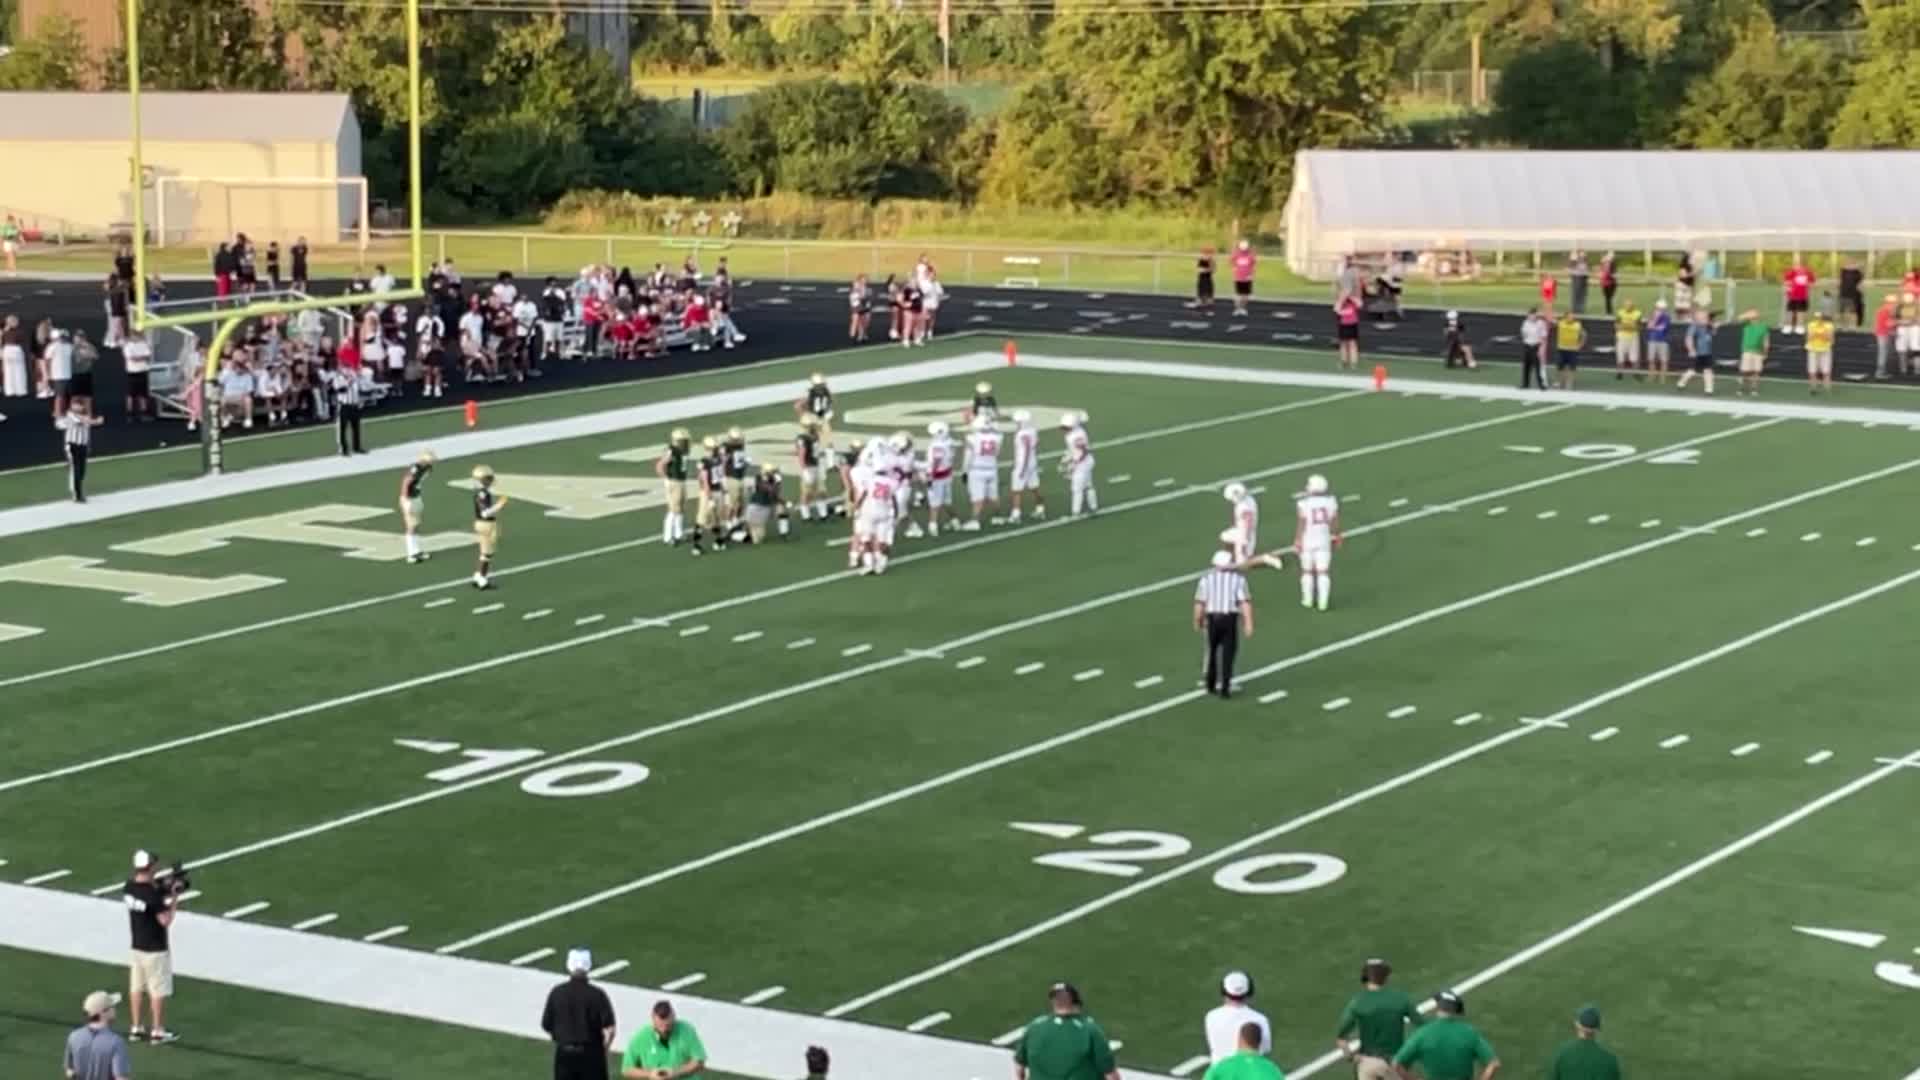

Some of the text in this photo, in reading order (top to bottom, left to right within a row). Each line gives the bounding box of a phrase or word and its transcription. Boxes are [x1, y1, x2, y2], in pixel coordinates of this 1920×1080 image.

[0, 398, 1088, 643] ITANS
[424, 748, 650, 797] 10
[1032, 810, 1348, 894] 20
